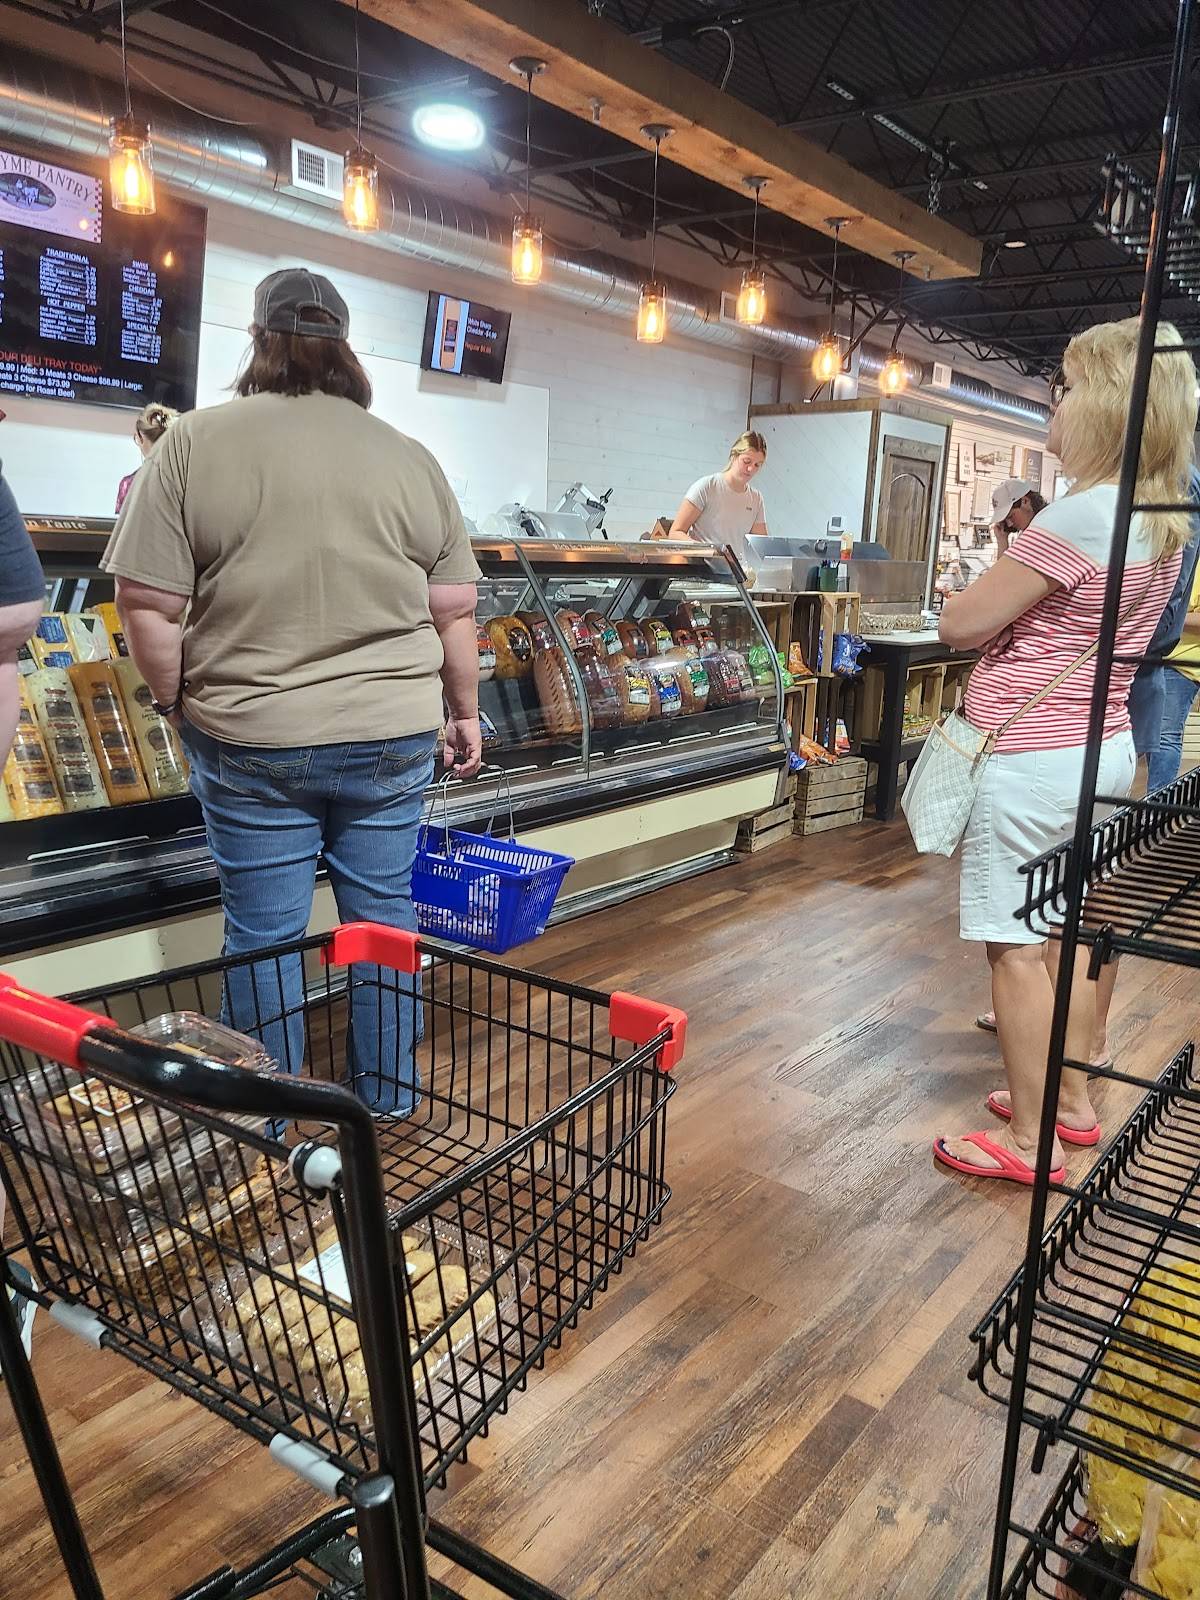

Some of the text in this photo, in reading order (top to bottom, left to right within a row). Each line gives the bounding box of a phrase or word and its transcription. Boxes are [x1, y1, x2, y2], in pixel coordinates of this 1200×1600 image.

[37, 164, 93, 202] PANTRY
[46, 247, 89, 265] TRADITIONAL
[47, 296, 86, 312] HOT PEPPER
[20, 353, 42, 366] DELI
[44, 356, 68, 370] TRAY
[20, 374, 46, 386] Cheese
[73, 372, 98, 385] Cheese
[1, 381, 24, 393] charge
[26, 384, 36, 393] for
[37, 385, 57, 396] Roast
[41, 519, 88, 530] Taste
